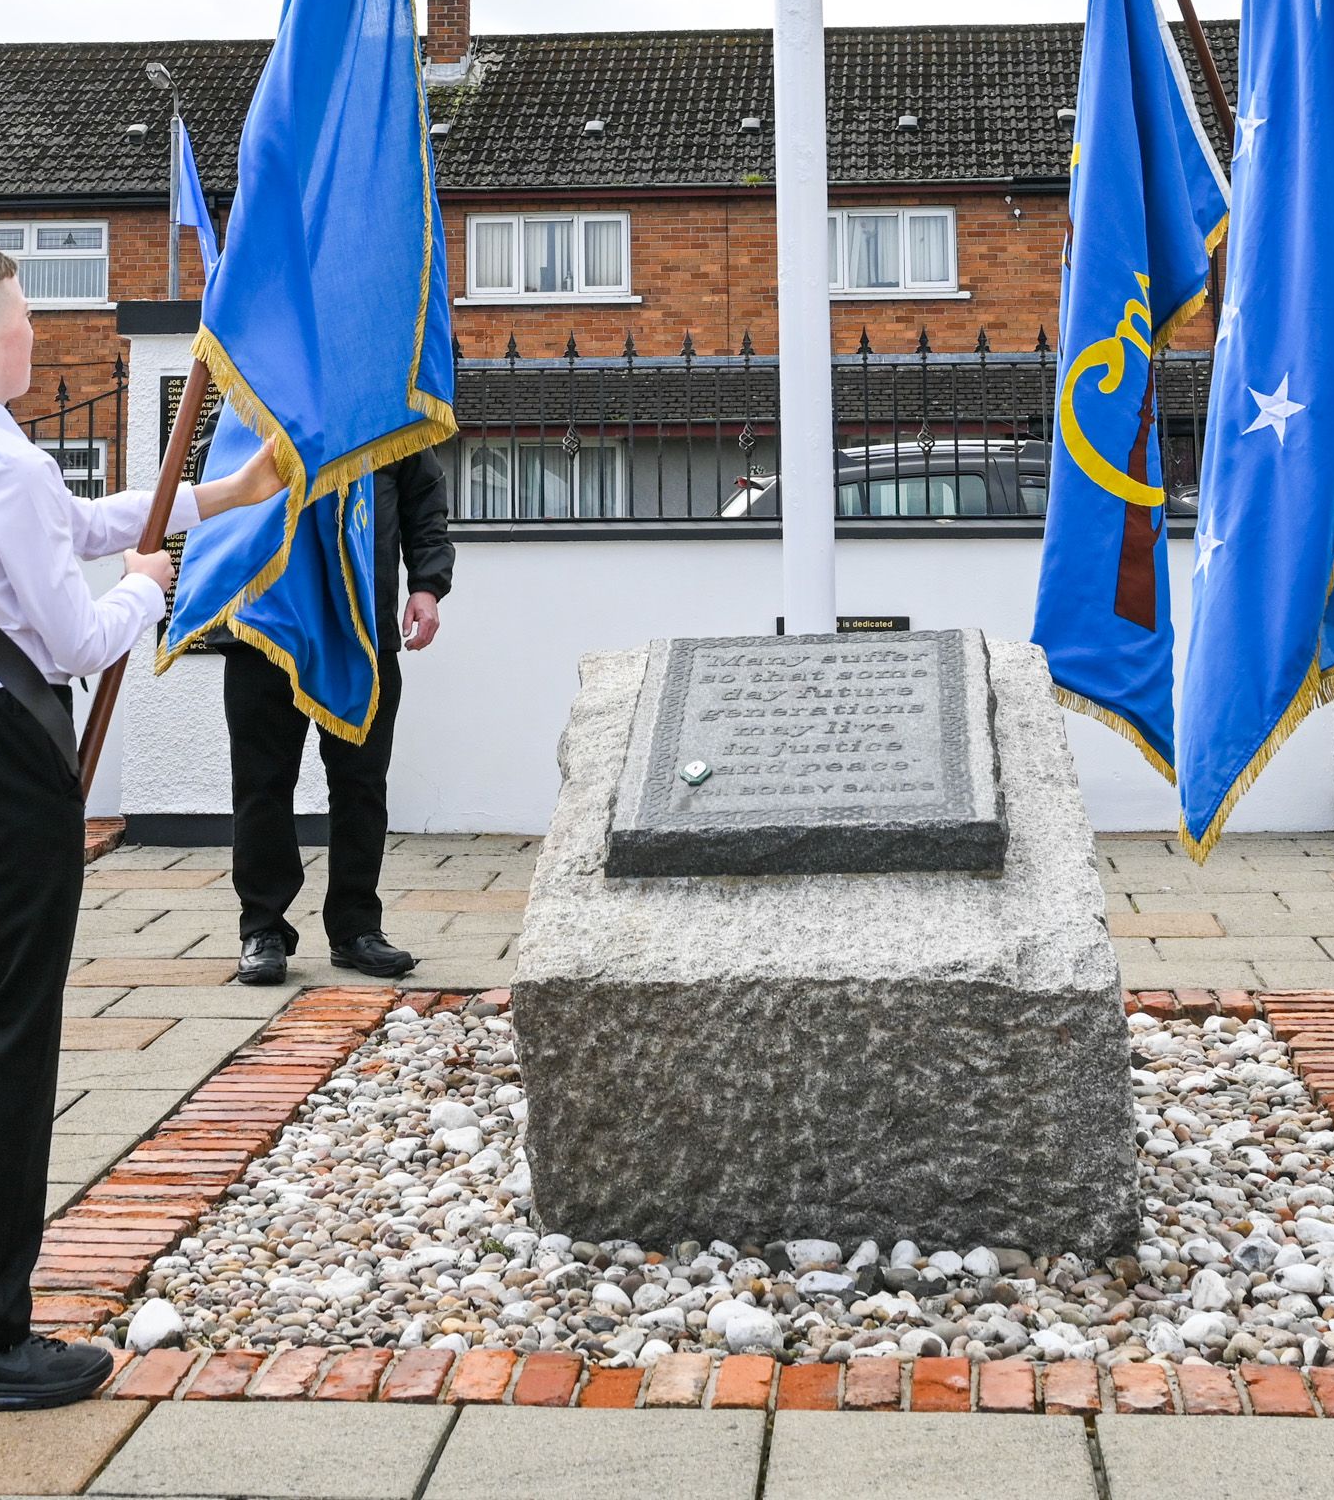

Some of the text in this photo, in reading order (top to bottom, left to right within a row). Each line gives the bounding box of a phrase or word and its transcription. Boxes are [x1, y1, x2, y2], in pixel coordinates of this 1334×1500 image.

[843, 620, 850, 628] is
[853, 620, 893, 628] dedicated
[821, 650, 929, 664] suffer
[698, 669, 928, 684] so that some
[722, 686, 914, 702] day future
[699, 703, 925, 722] generations
[733, 721, 896, 738] may live
[722, 740, 903, 758] in justice
[715, 761, 787, 776] and
[739, 784, 834, 796] BOBBY
[842, 782, 935, 794] SANDS
